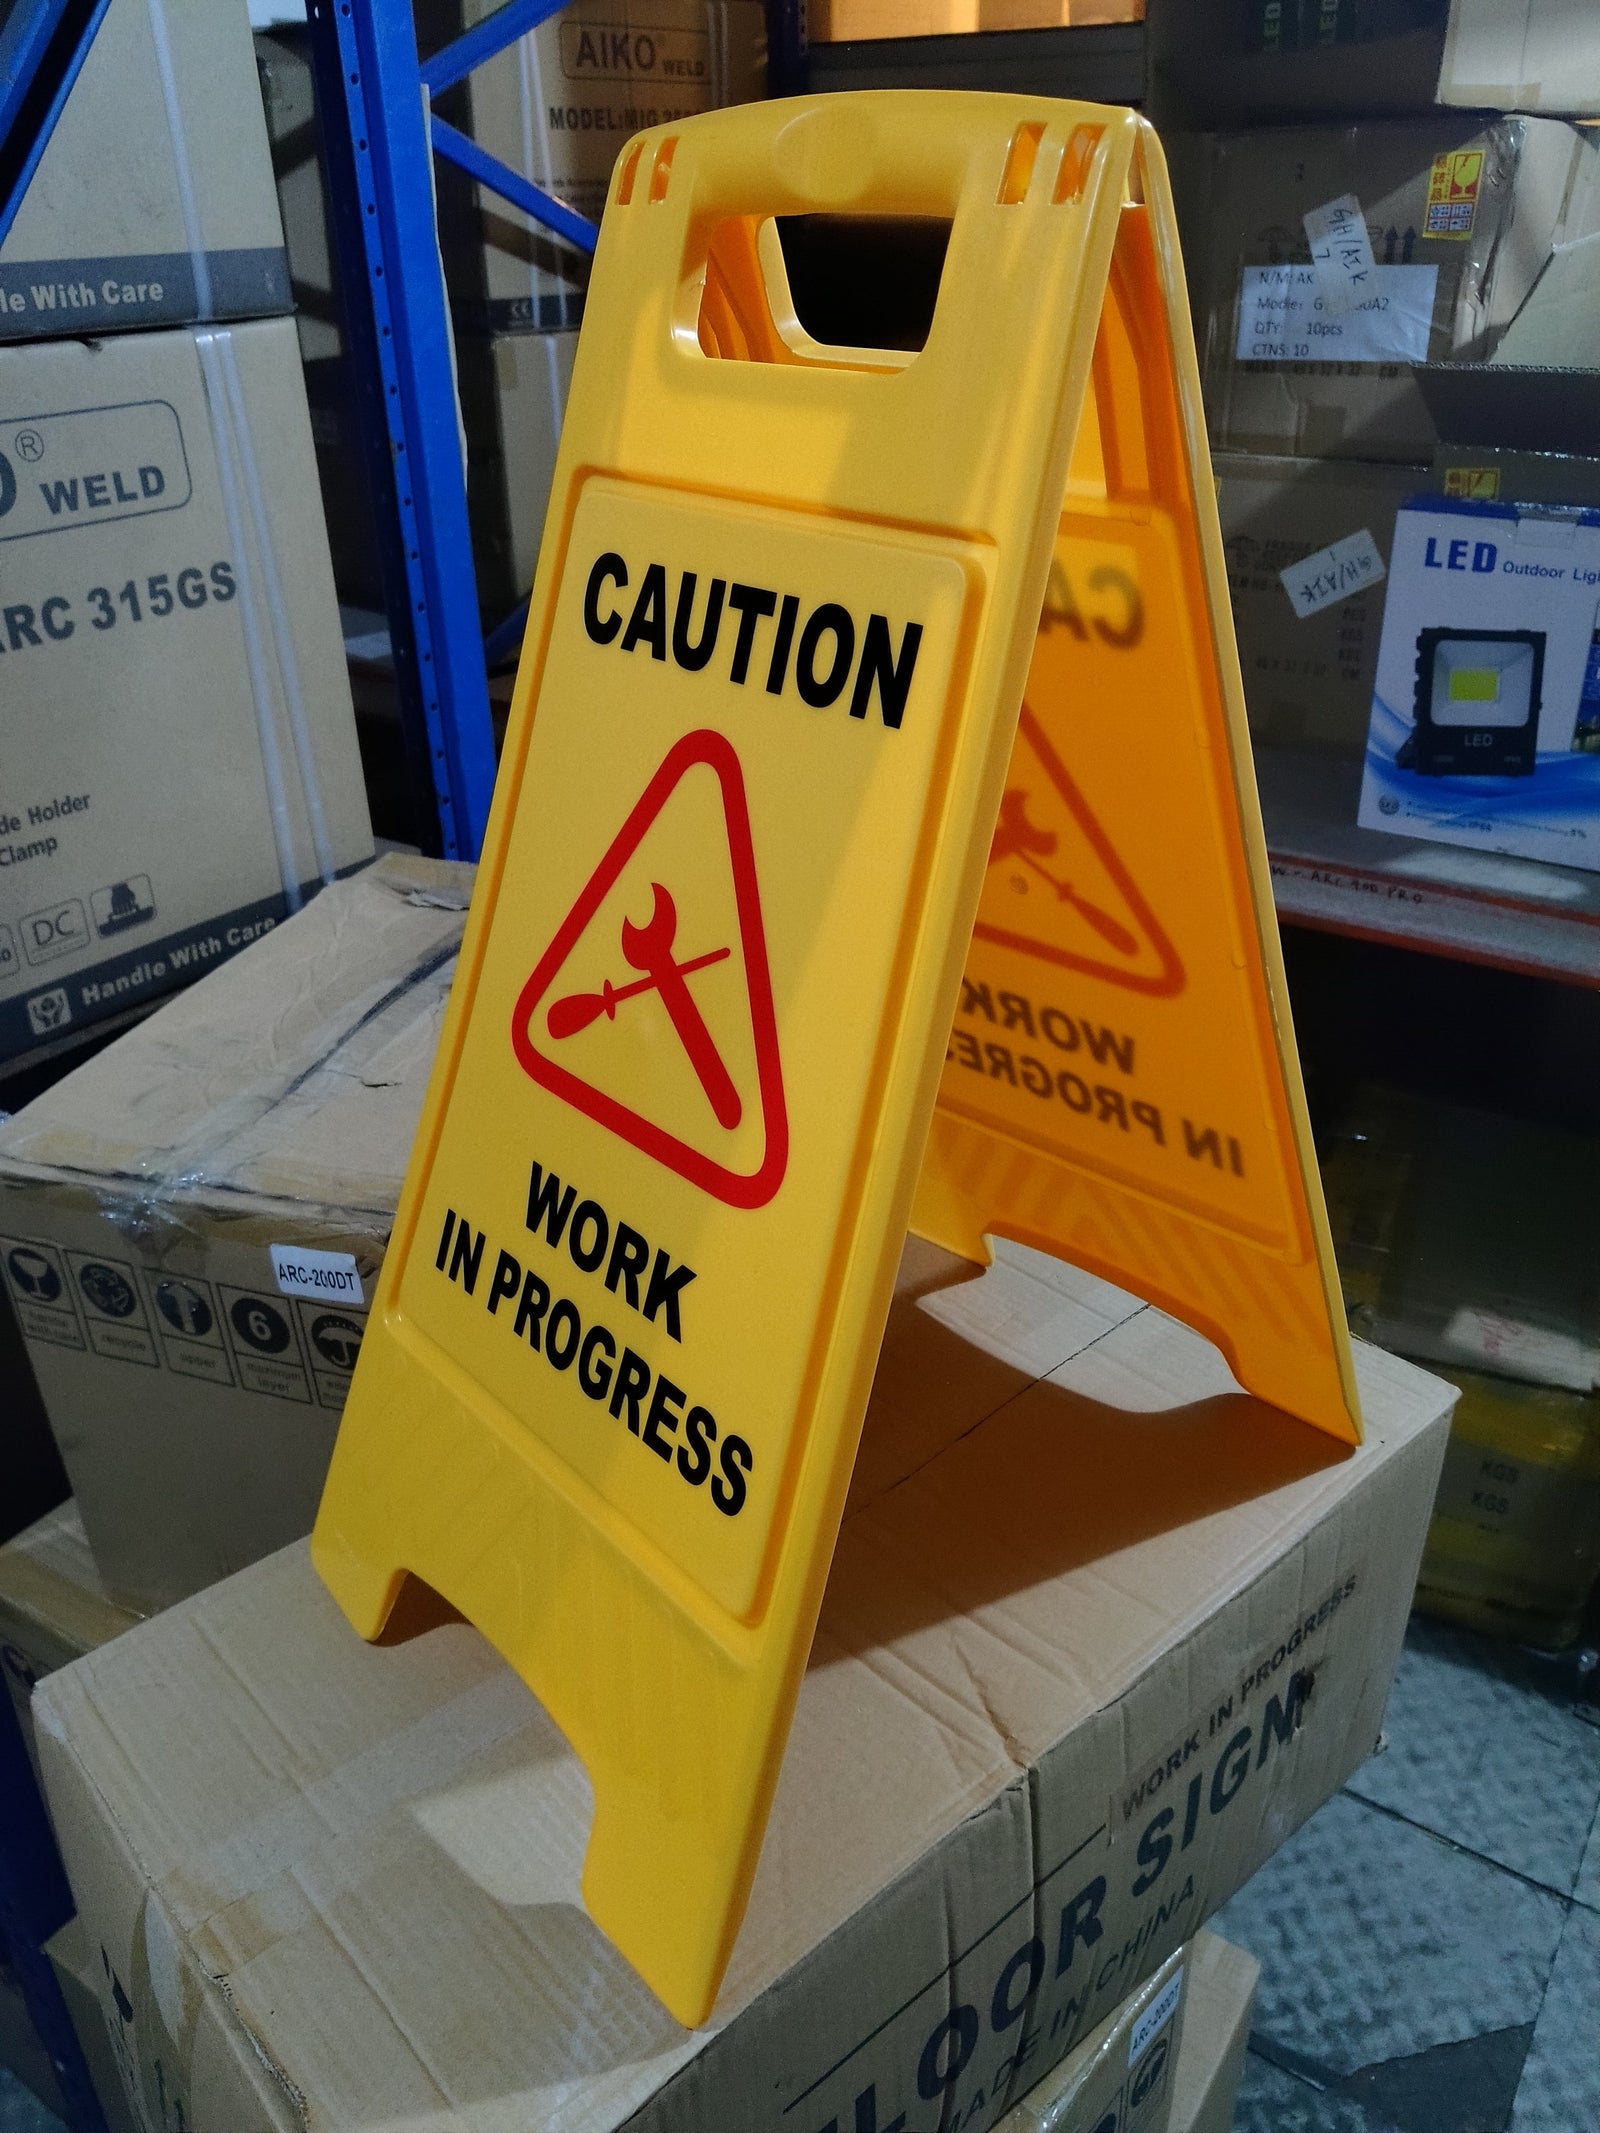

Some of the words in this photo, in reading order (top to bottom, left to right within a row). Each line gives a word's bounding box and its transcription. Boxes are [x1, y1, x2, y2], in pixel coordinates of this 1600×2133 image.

[575, 30, 656, 71] AIKO
[30, 281, 97, 311] With
[101, 279, 164, 305] Care
[40, 466, 165, 515] WELD
[1425, 537, 1498, 573] LED
[1502, 560, 1566, 578] Outdoor
[0, 597, 74, 653] RC
[87, 561, 238, 631] 315GS
[584, 553, 923, 729] CAUTION
[1463, 732, 1495, 748] LED
[27, 794, 91, 825] Holder
[33, 910, 75, 946] DC
[81, 961, 167, 1006] Handle
[168, 936, 222, 969] With
[226, 916, 276, 946] Care
[279, 1263, 354, 1292] ARC-200DT
[526, 1161, 697, 1343] WORK
[436, 1209, 486, 1296] IN
[487, 1249, 752, 1516] PROGRESS
[1122, 1729, 1200, 1821] WORK
[1209, 1695, 1233, 1736] IN
[1095, 1874, 1193, 1992] CHINA
[816, 1876, 1107, 2133] LOOR
